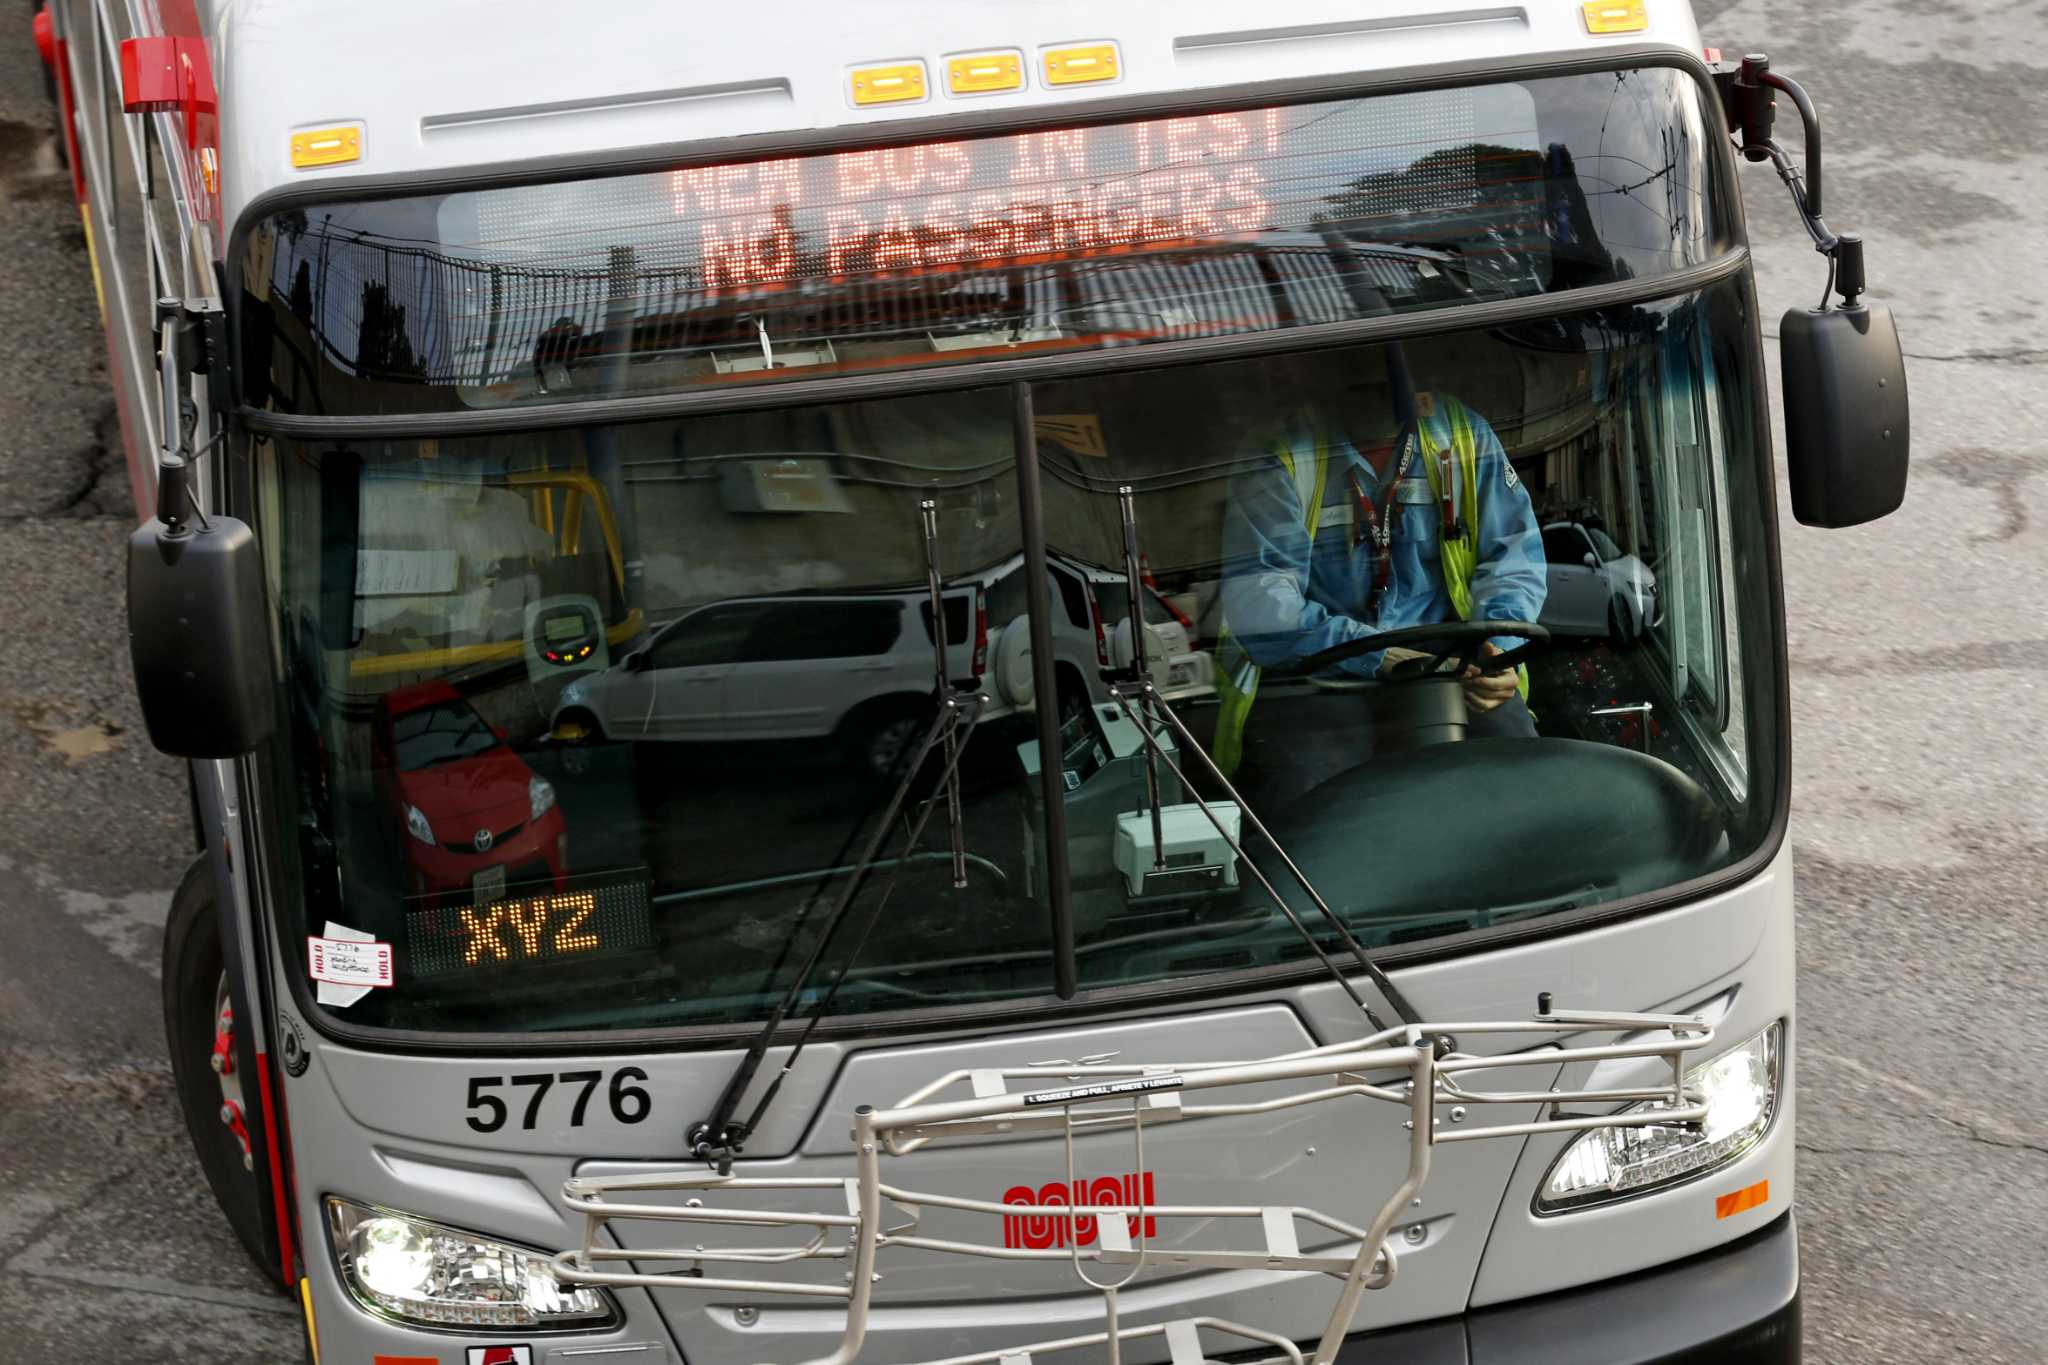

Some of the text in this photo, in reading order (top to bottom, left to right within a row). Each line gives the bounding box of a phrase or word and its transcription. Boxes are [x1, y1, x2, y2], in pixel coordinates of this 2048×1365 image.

[837, 142, 971, 198] BUS
[1009, 128, 1084, 180] IN
[701, 166, 1271, 287] NO PASSENGERS
[314, 944, 325, 973] HOLD
[460, 894, 599, 963] XYZ
[378, 950, 390, 979] HOLD
[465, 1066, 652, 1134] 5776
